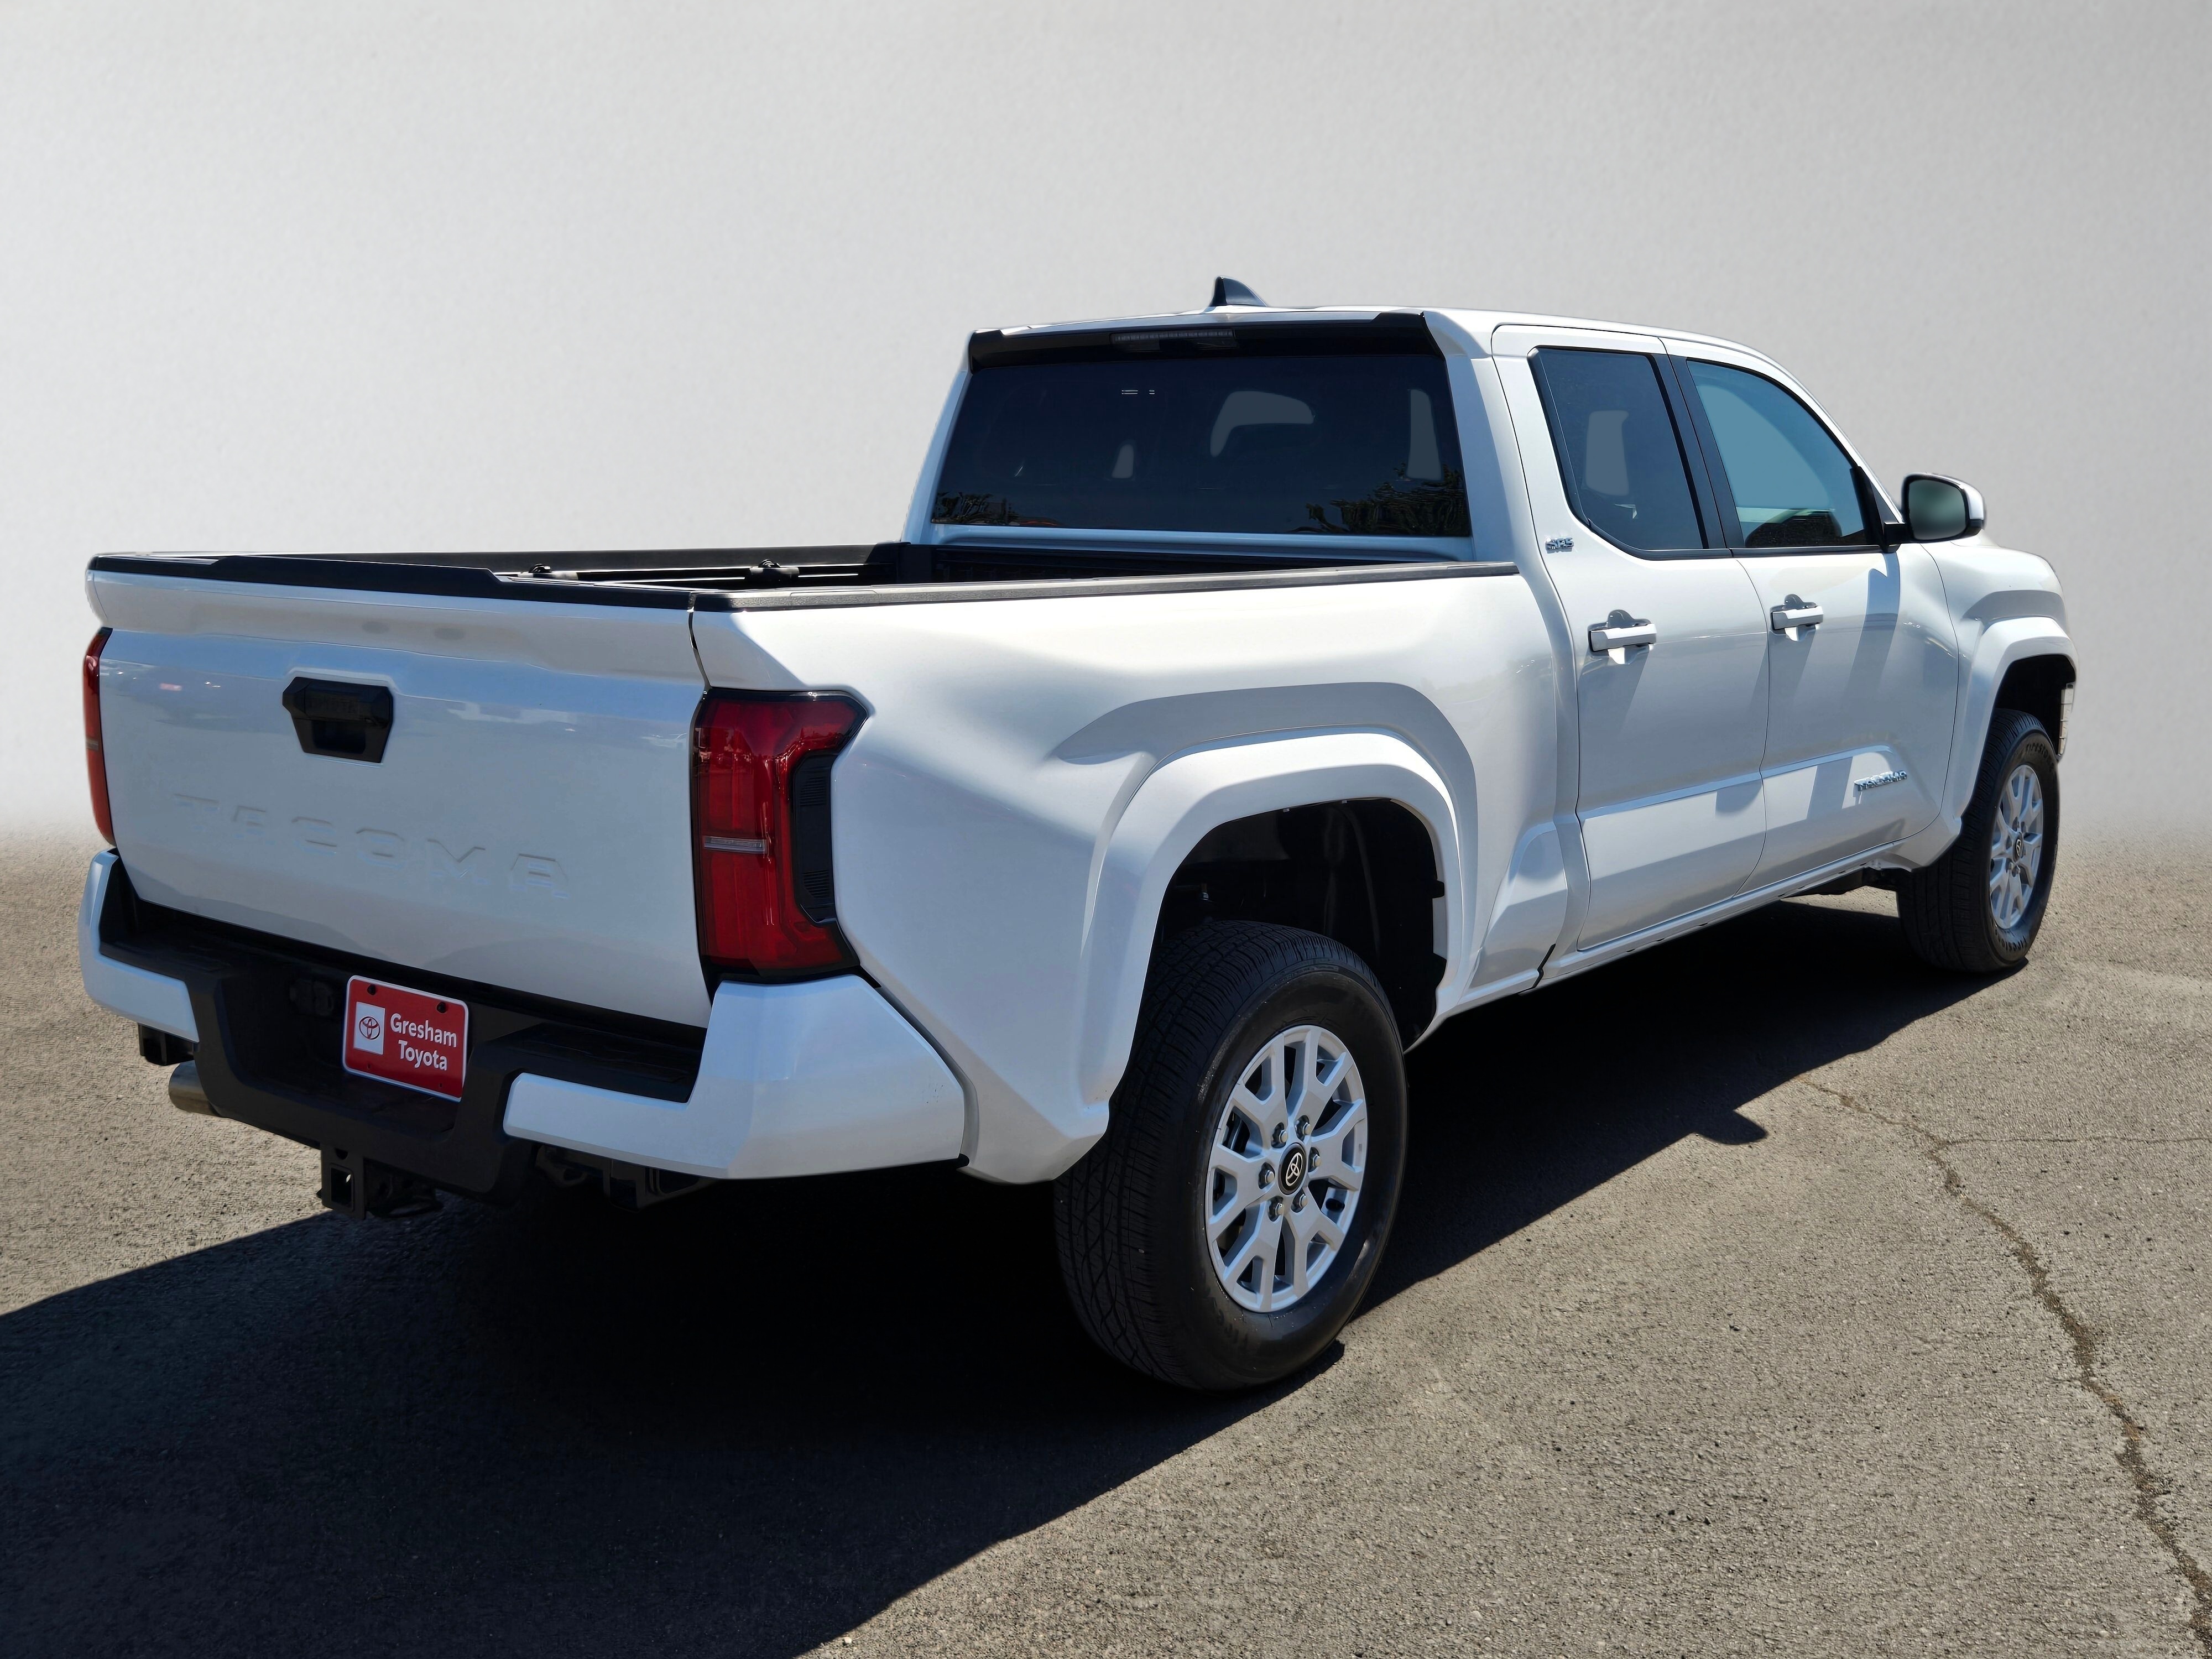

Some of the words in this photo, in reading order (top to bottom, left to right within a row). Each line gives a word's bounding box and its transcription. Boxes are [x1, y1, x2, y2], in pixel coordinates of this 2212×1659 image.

[174, 793, 570, 899] TACOMA
[390, 1013, 457, 1047] Gresham
[398, 1040, 447, 1071] Toyota
